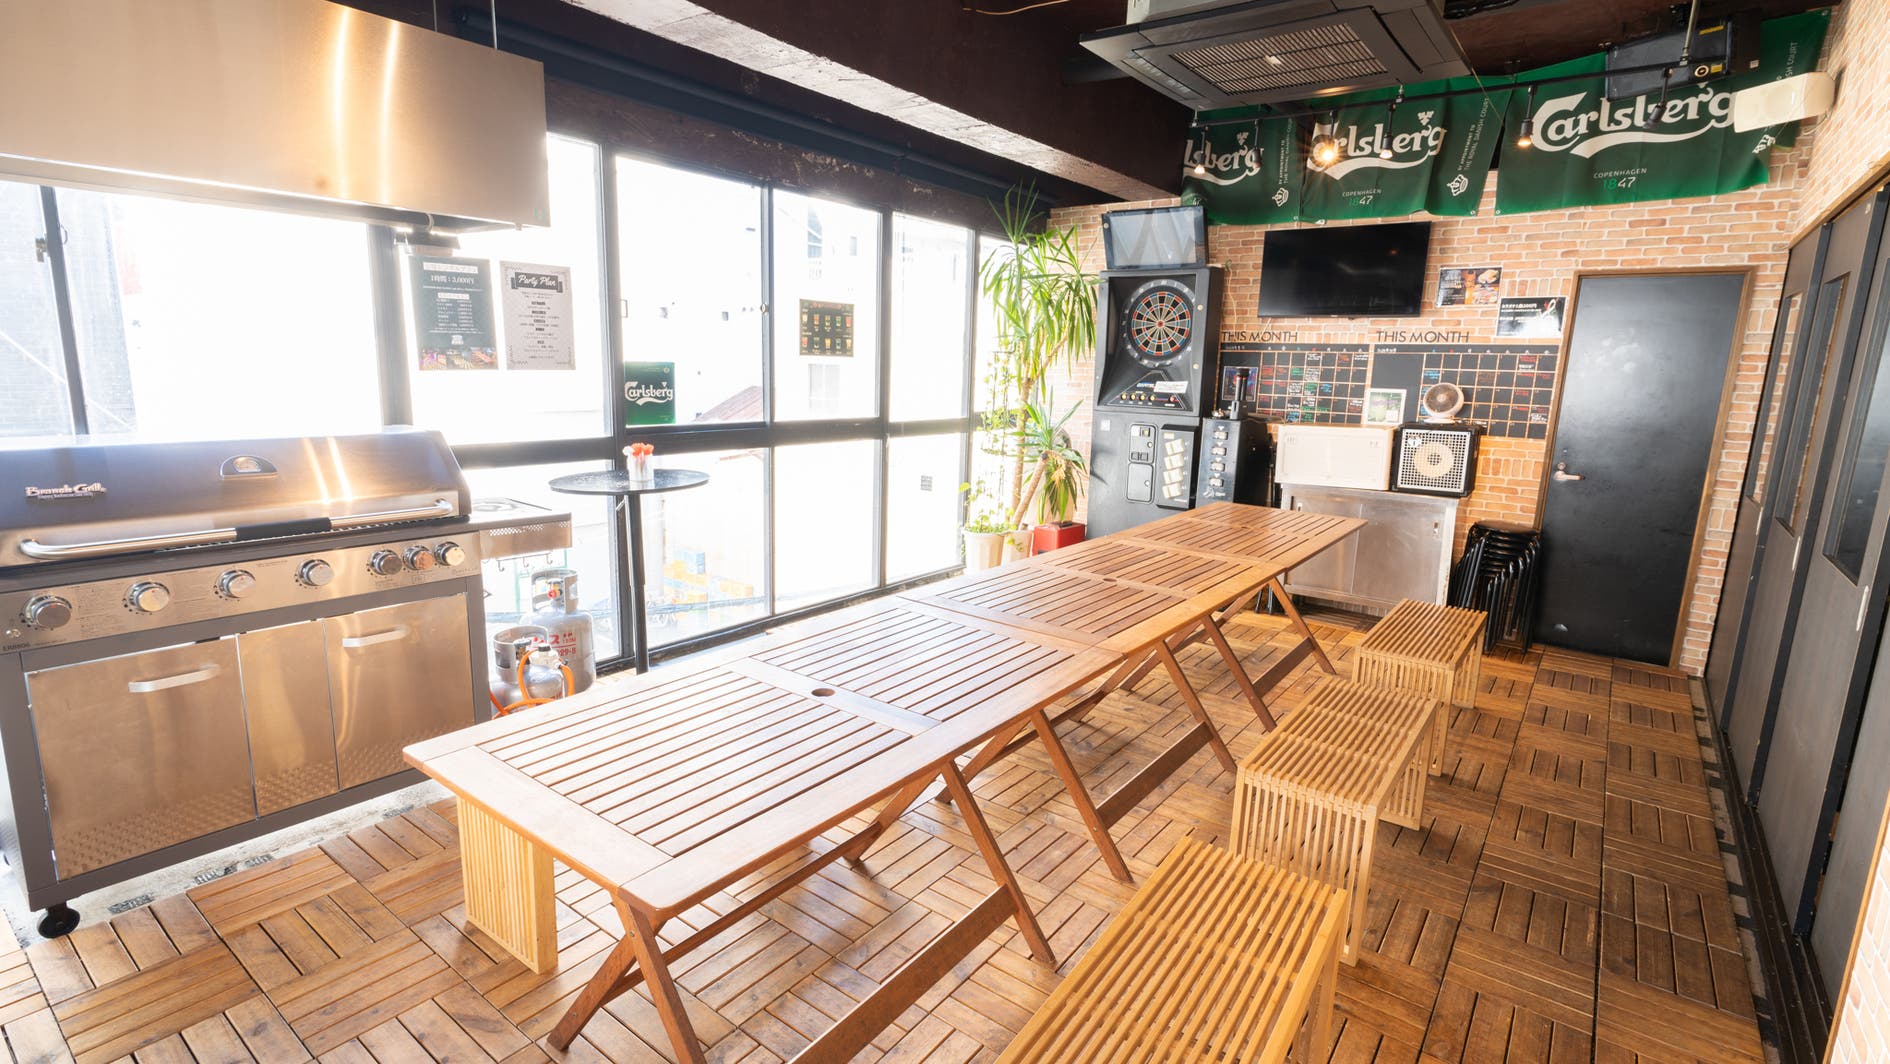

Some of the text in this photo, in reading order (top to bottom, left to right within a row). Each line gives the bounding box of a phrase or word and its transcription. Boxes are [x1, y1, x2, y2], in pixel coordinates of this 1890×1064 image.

[1532, 83, 1735, 153] Carlsberg
[1593, 167, 1648, 179] COPENHAGEN
[1602, 176, 1637, 190] 1847
[1342, 188, 1382, 198] COPENHAGEN
[517, 274, 556, 287] Party Plan
[1221, 330, 1298, 342] THIS MONTH
[1376, 330, 1470, 343] THIS MONTH
[624, 381, 674, 402] Carlsberg
